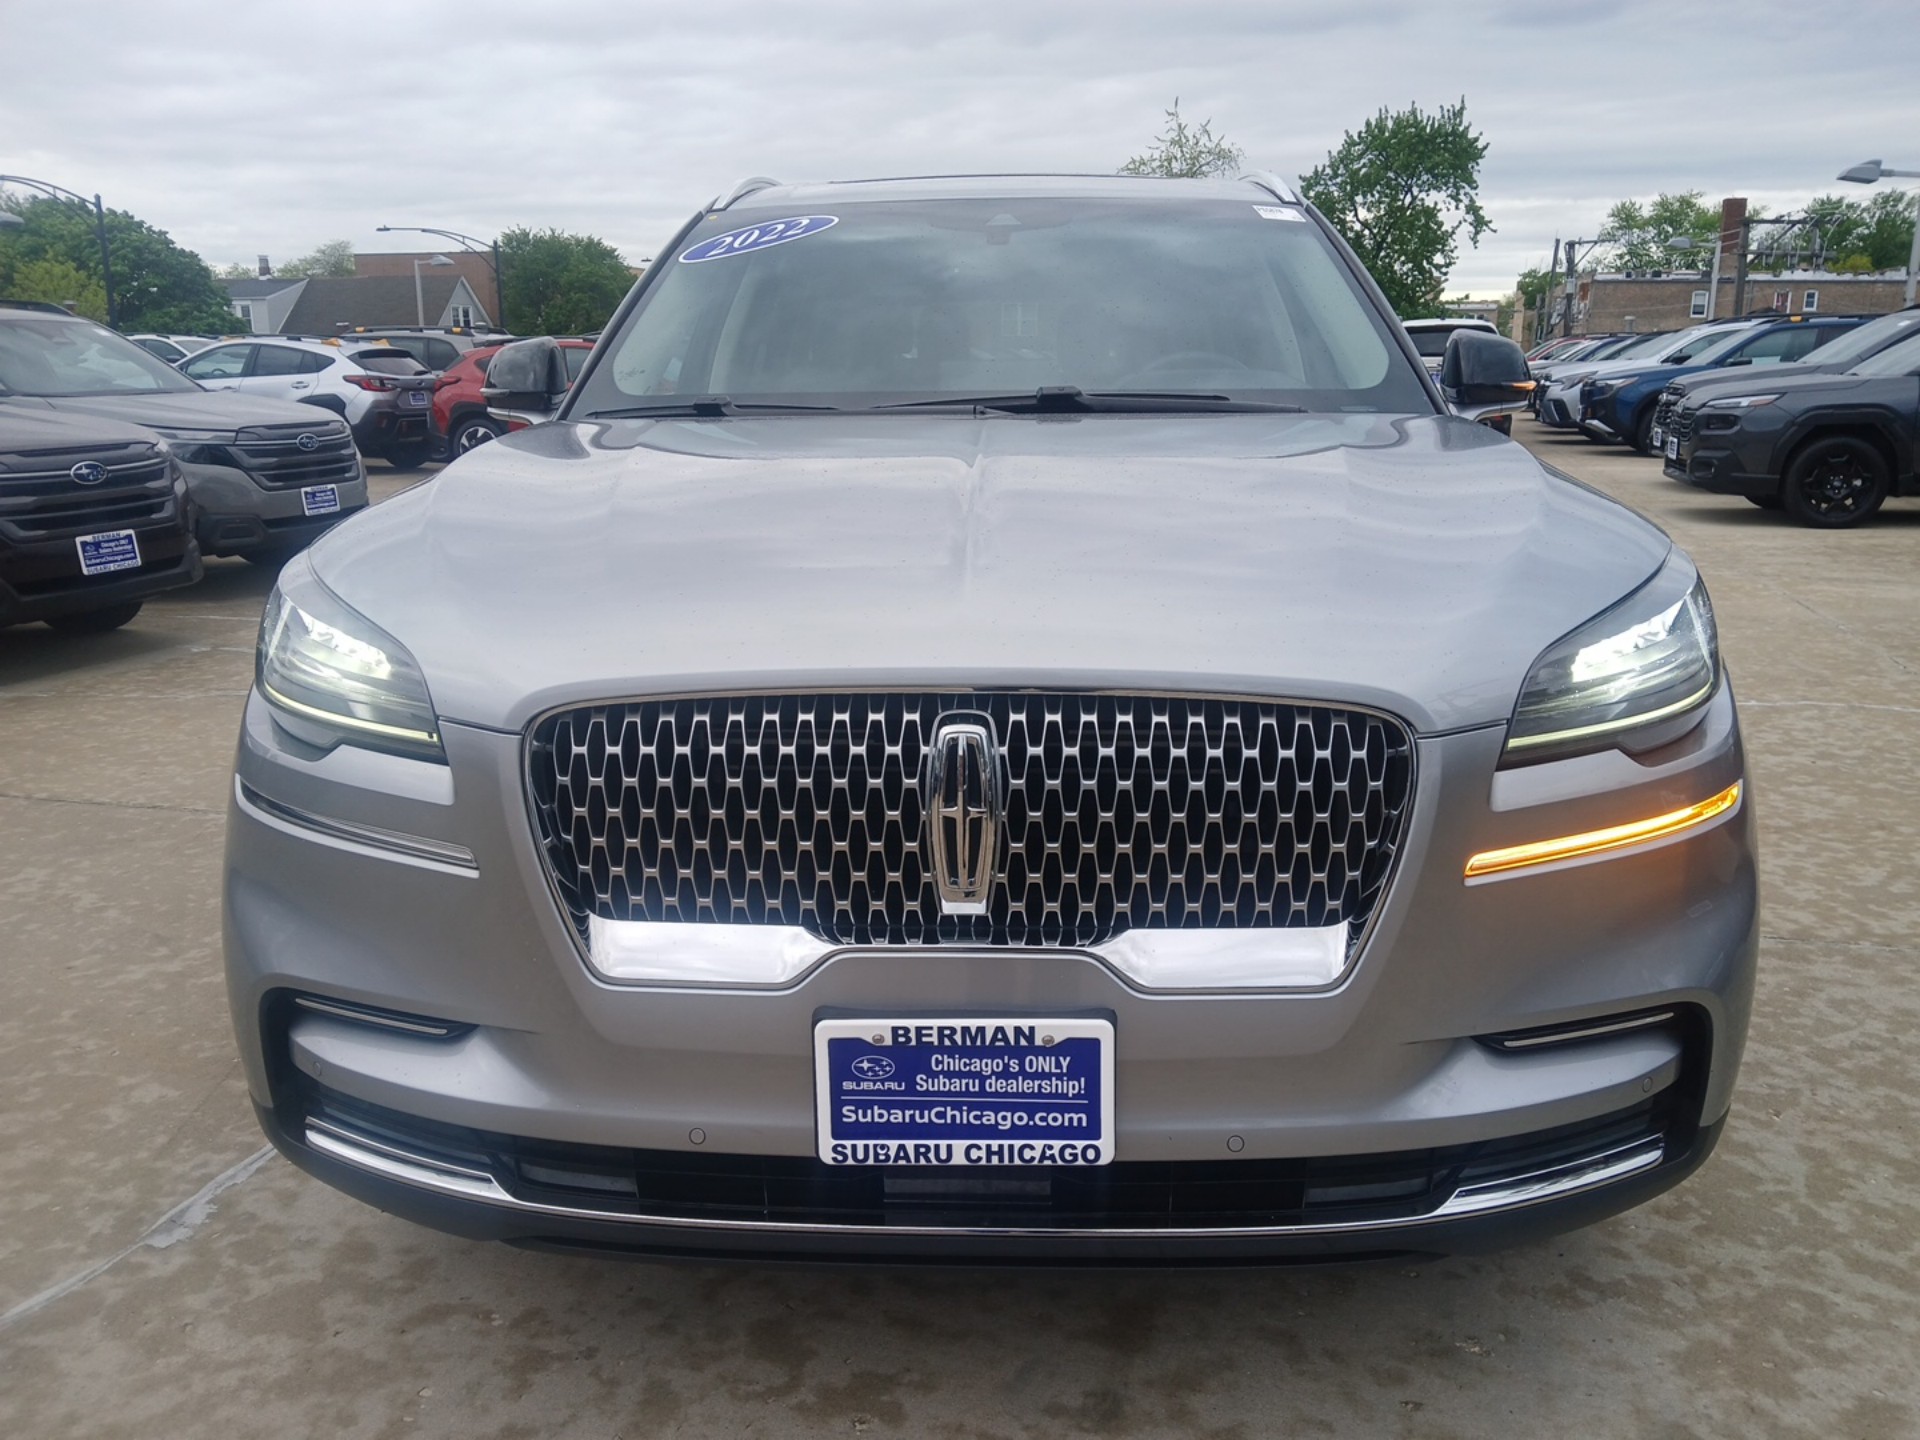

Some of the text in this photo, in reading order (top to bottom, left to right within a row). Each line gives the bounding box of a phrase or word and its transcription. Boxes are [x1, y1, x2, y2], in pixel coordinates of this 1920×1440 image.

[705, 218, 811, 258] 2022
[891, 1026, 1036, 1046] BERMAN
[931, 1054, 1071, 1075] Chicago's ONLY
[842, 1081, 905, 1091] SUBARU
[915, 1075, 1086, 1097] Subaru dealership!
[841, 1105, 1088, 1130] SubaruChicago.com
[830, 1143, 1102, 1165] SUBARU CHICAGO
